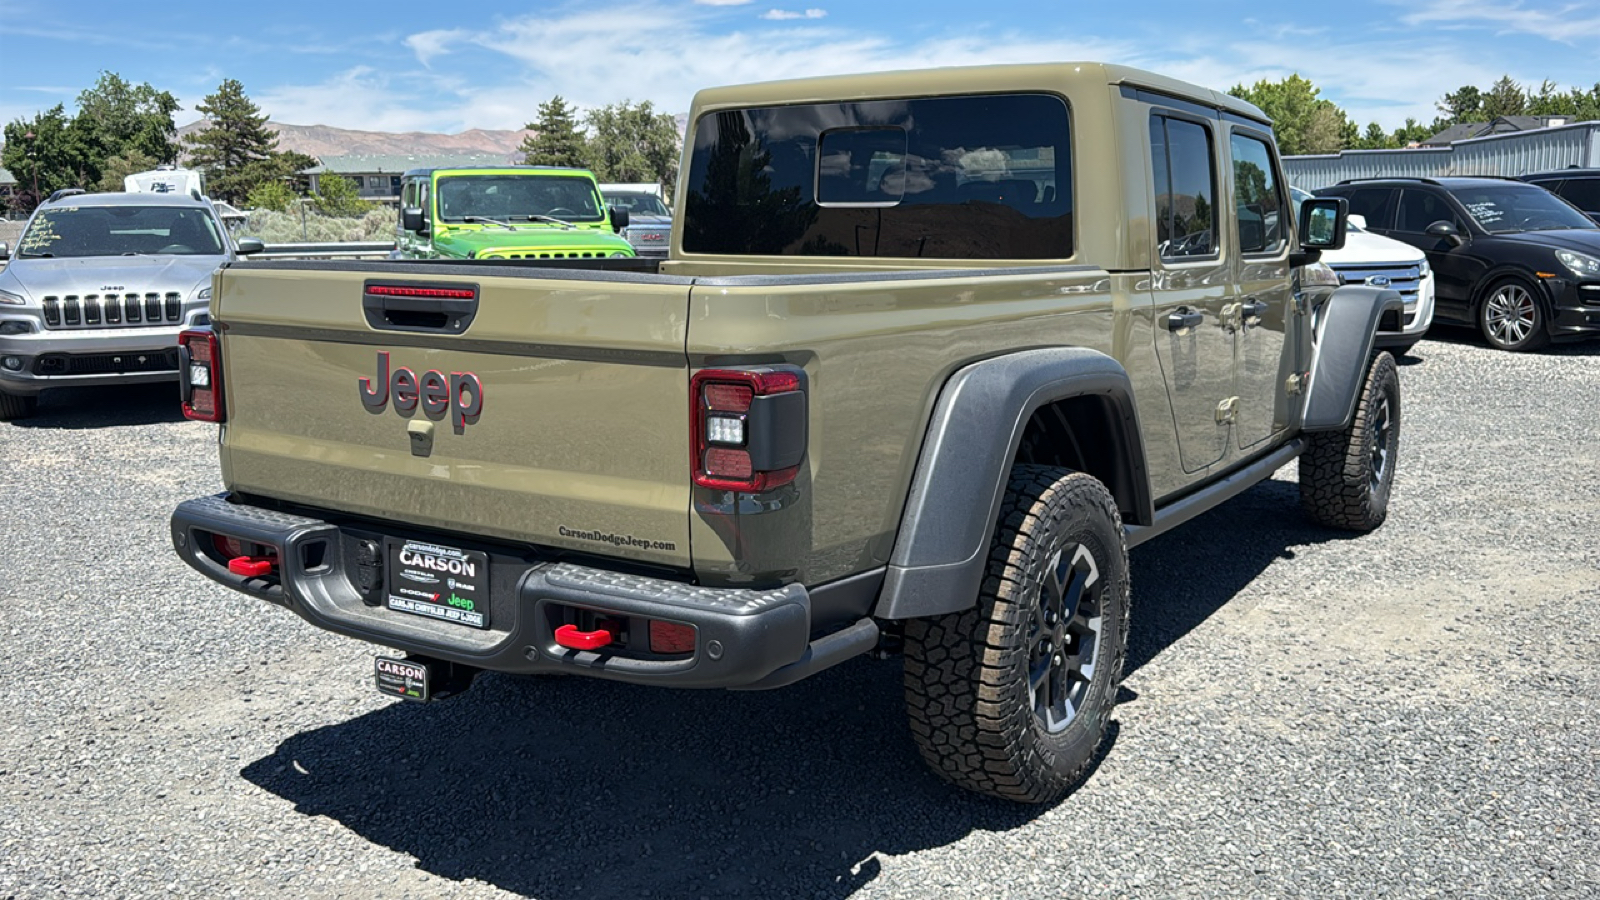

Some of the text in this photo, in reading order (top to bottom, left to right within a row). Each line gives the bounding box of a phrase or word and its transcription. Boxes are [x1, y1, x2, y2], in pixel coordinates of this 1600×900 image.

[358, 350, 483, 428] Jeep
[558, 525, 676, 551] CarsonDodgeJeep.com
[399, 550, 475, 577] CARSON
[399, 588, 435, 599] DODGE
[455, 582, 475, 592] RAM
[447, 592, 475, 611] Jeep
[378, 661, 423, 680] CARSON
